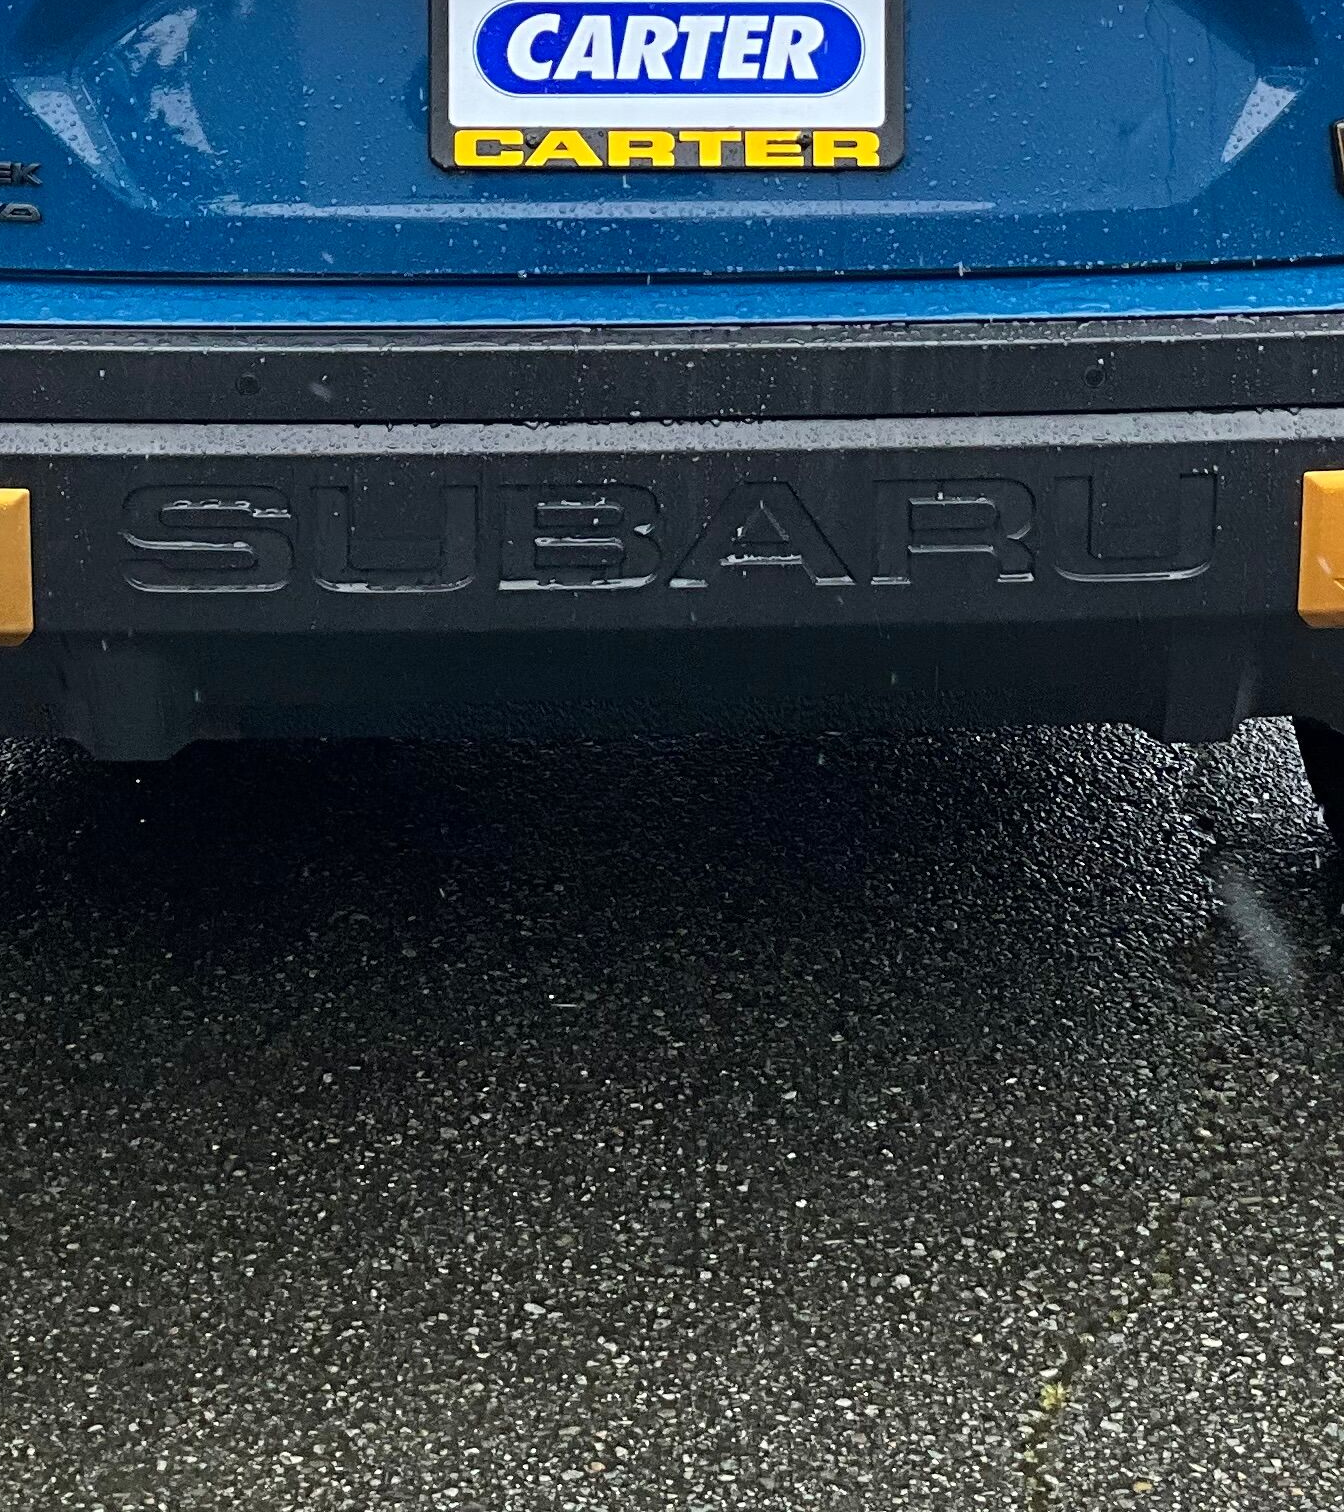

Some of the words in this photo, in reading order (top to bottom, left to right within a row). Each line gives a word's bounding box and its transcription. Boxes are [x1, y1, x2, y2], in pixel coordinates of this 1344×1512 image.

[507, 13, 825, 81] CARTER
[453, 129, 880, 168] CARTER
[118, 468, 1220, 594] SUBARU
